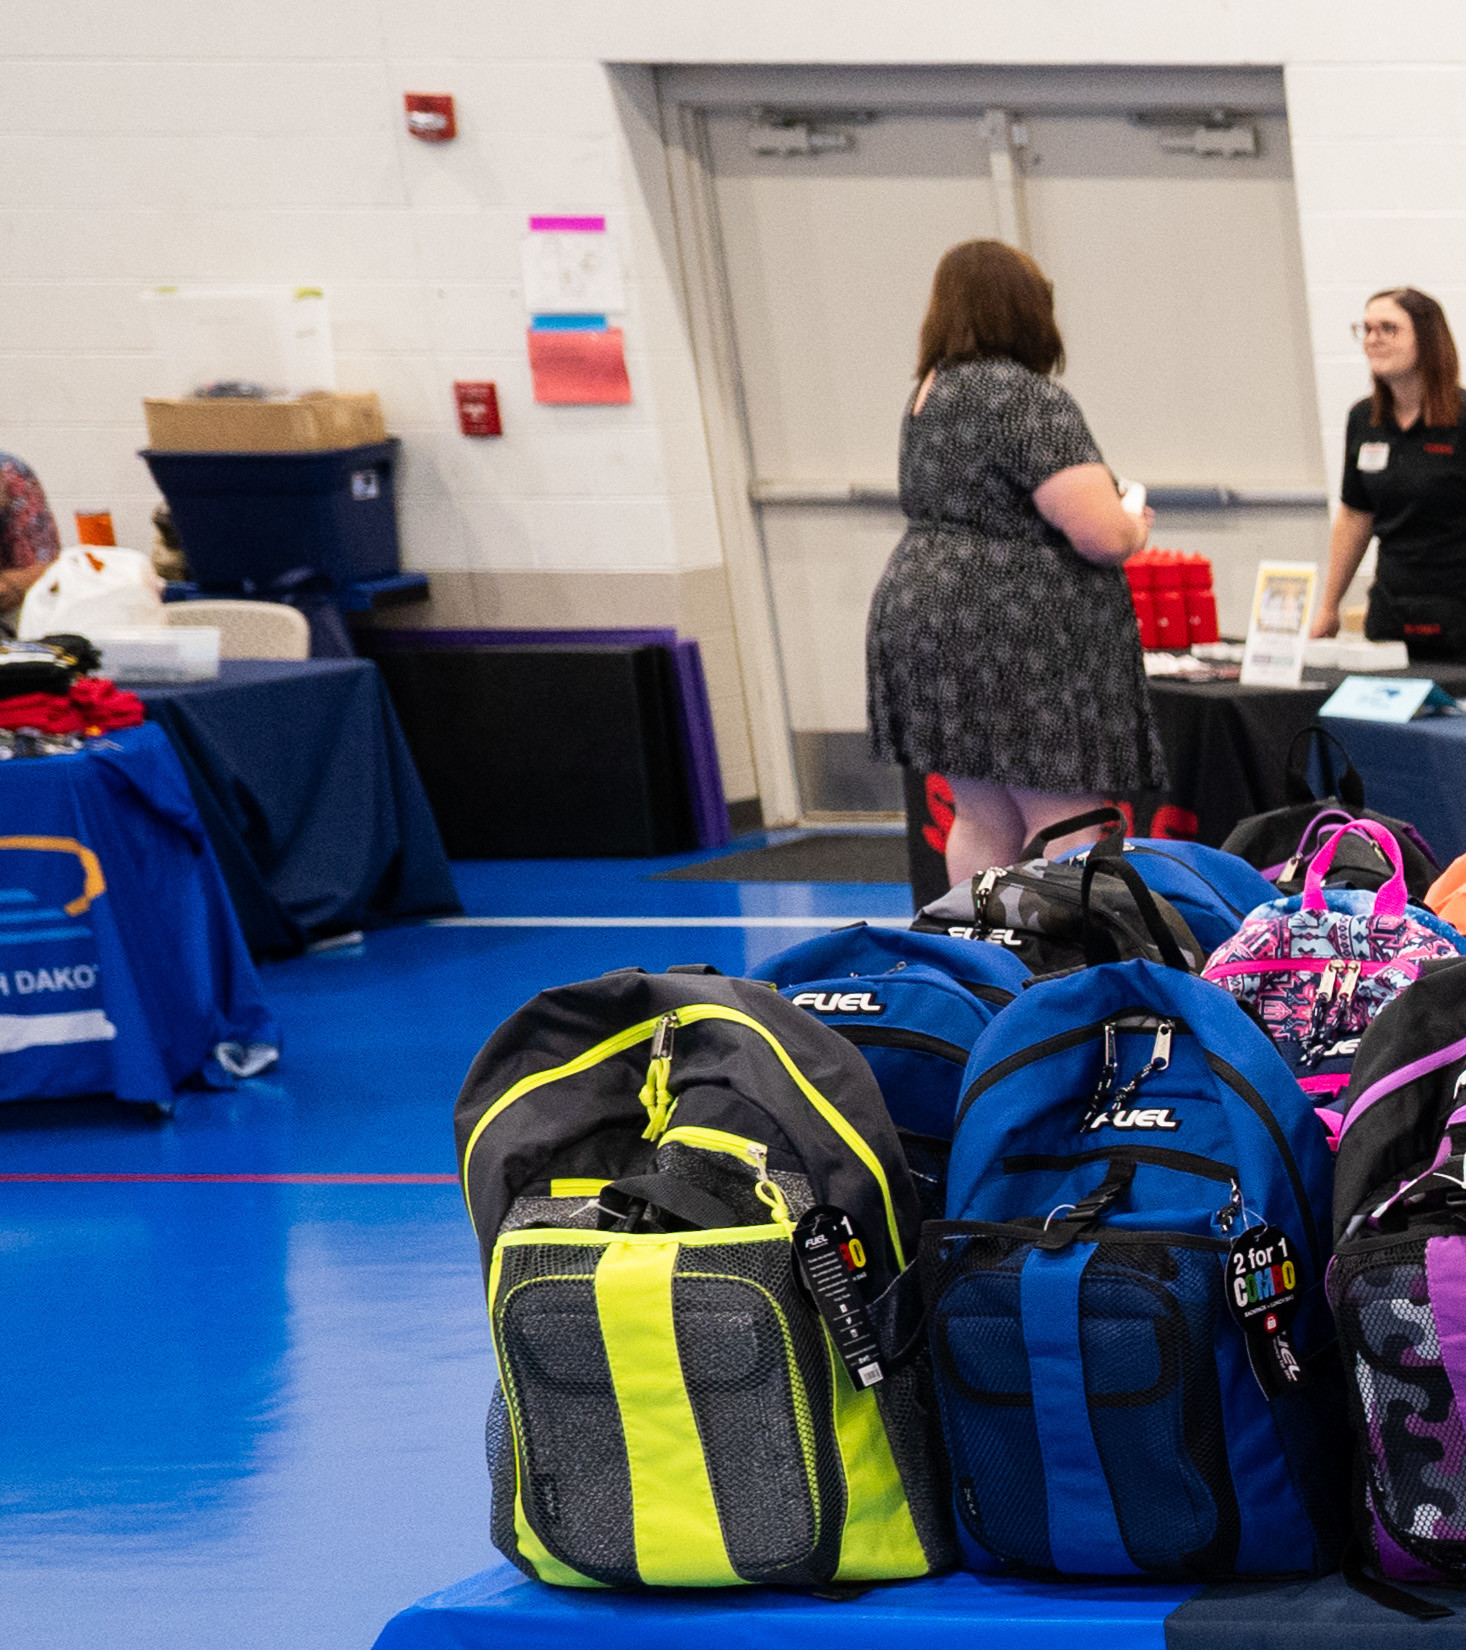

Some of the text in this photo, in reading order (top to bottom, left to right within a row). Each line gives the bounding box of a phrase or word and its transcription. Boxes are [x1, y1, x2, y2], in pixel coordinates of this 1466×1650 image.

[14, 964, 98, 995] DAKO
[793, 993, 880, 1011] FUEL
[804, 1235, 828, 1249] FUEL
[1233, 1237, 1288, 1275] 2 for 1
[1233, 1260, 1296, 1308] COMBO
